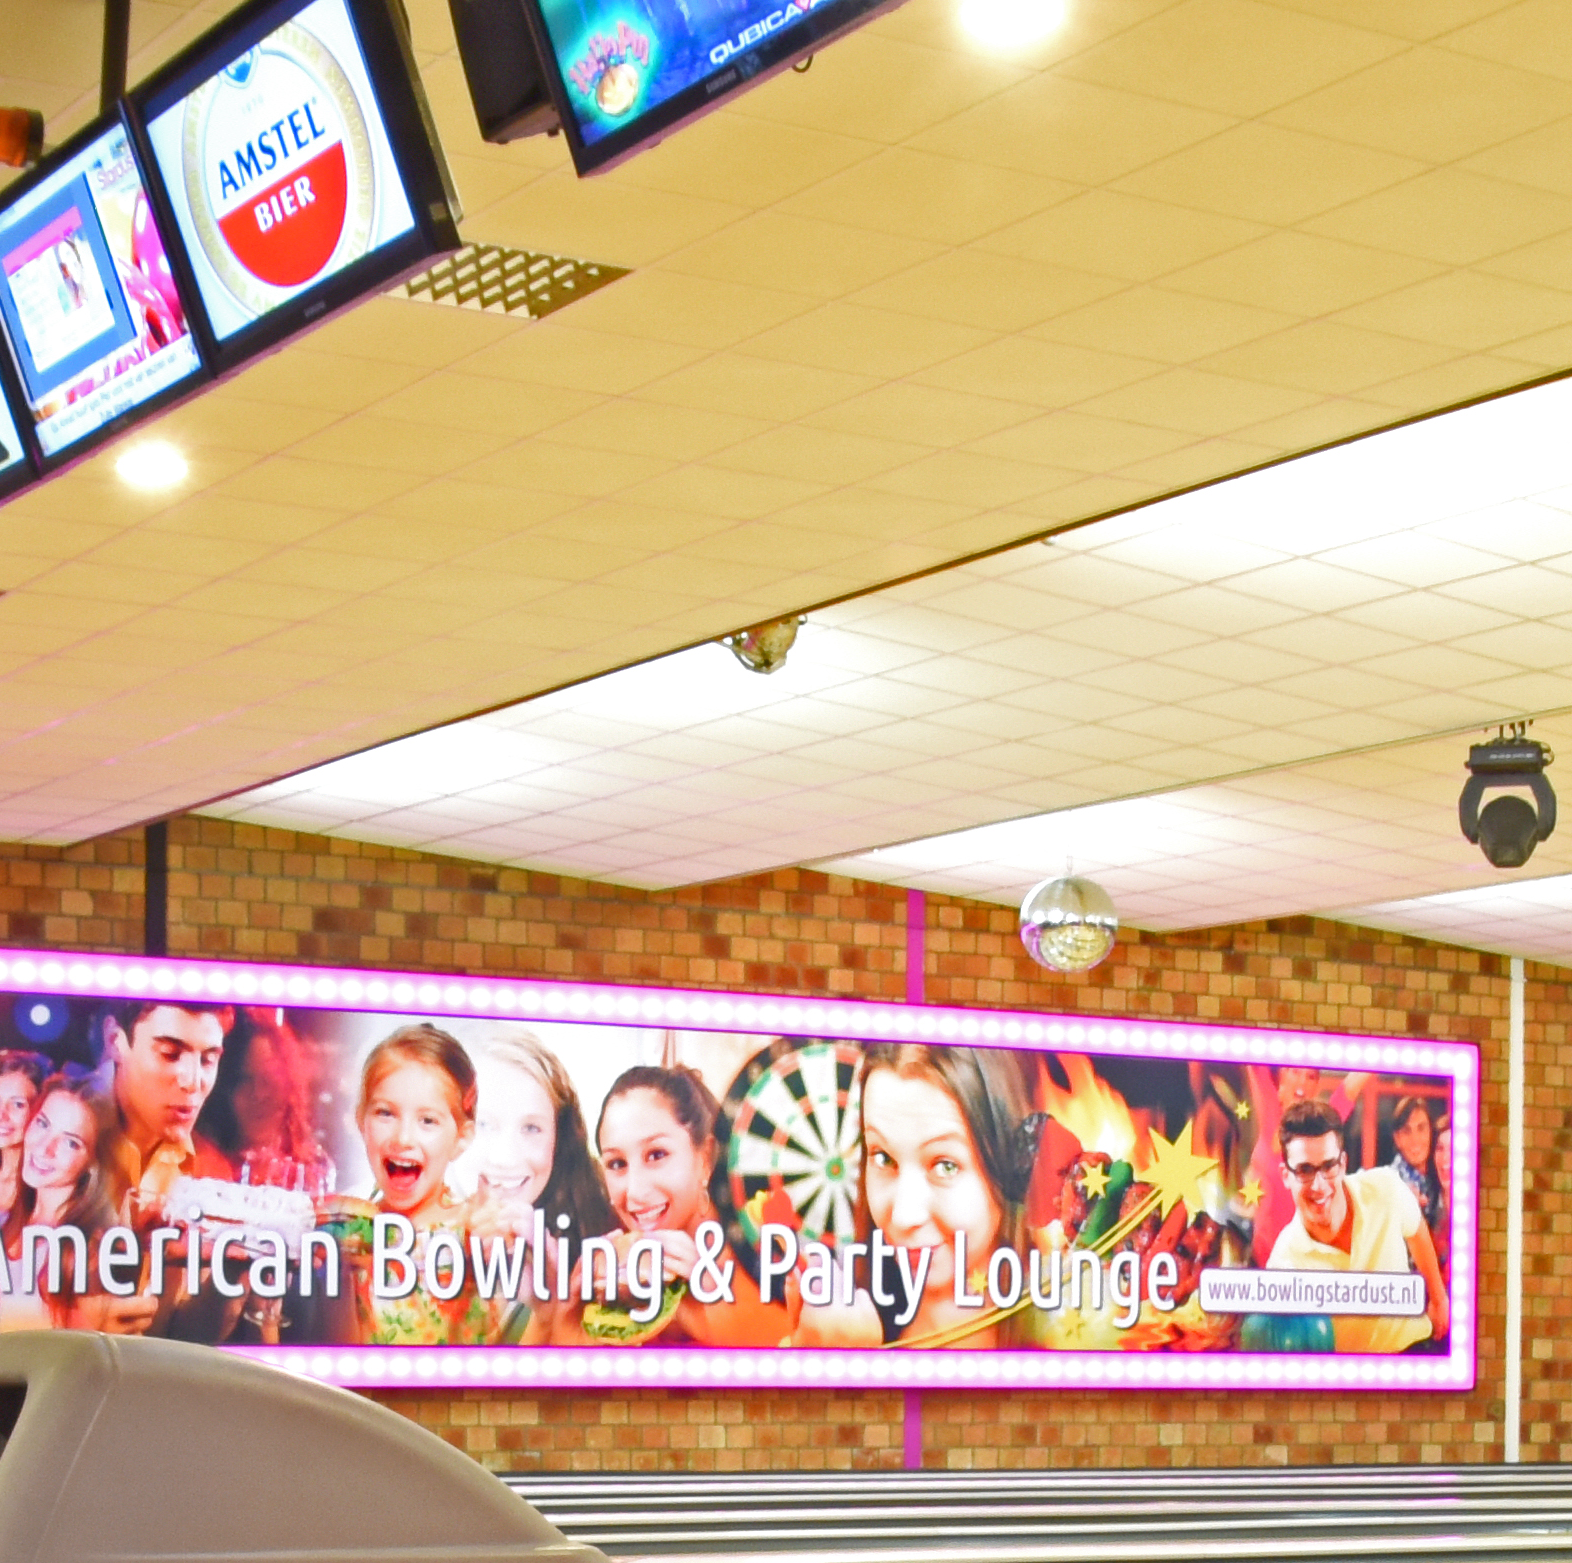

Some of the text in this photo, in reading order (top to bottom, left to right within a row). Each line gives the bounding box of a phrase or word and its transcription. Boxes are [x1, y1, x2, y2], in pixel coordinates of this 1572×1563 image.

[216, 102, 326, 200] AMSTEL
[253, 175, 316, 234] BIER
[372, 1208, 666, 1324] Bowling
[687, 1220, 736, 1305] &
[759, 1222, 933, 1326] Party
[954, 1229, 1179, 1329] Lounge
[1207, 1275, 1418, 1308] www.bowlingstardust.nl
